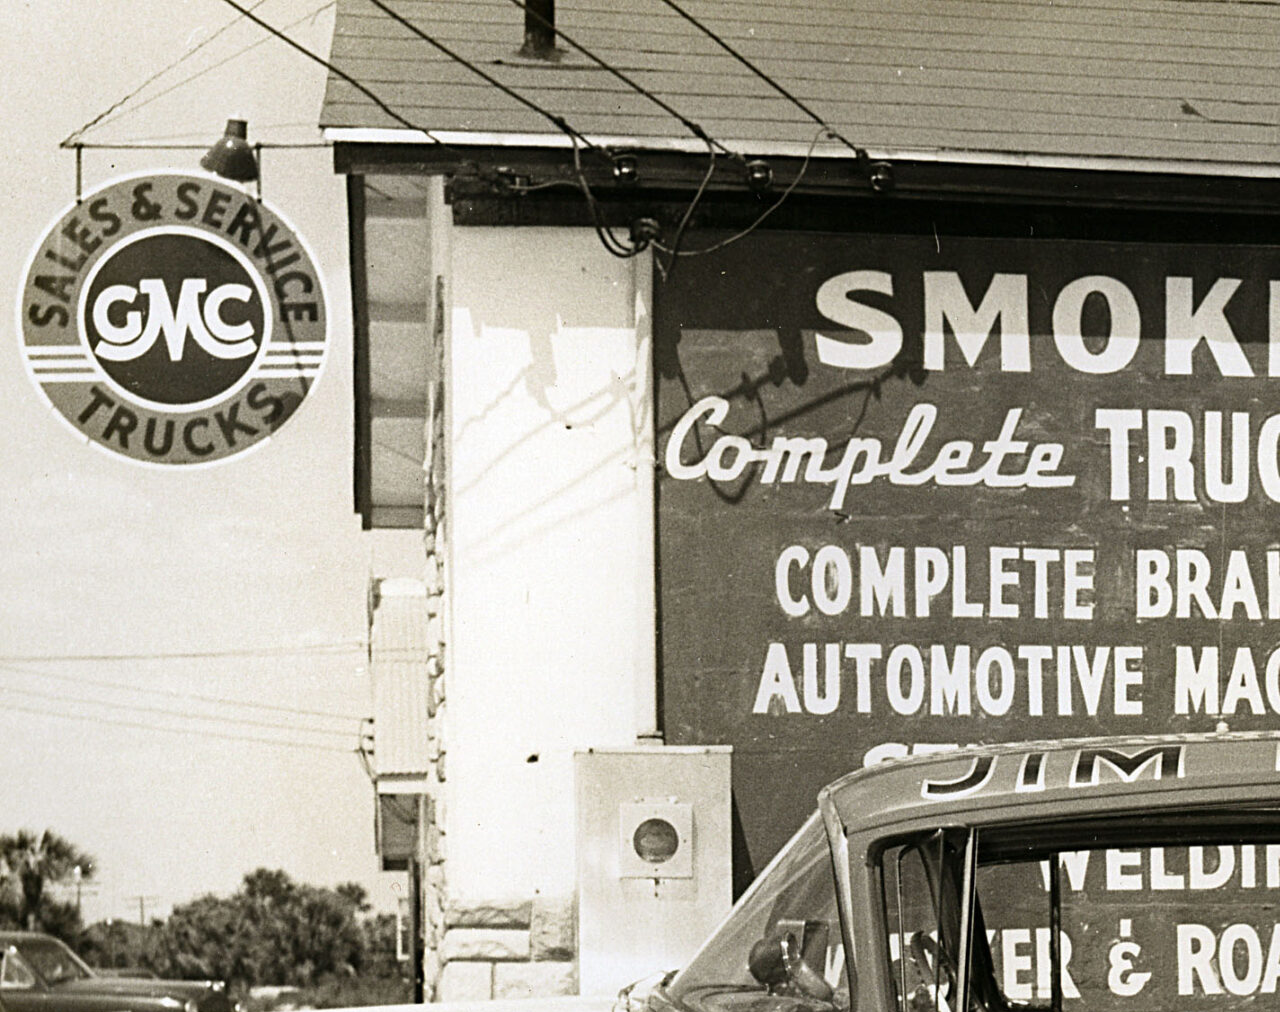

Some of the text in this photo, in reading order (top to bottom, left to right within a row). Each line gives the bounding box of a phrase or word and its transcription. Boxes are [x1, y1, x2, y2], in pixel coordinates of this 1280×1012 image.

[28, 182, 318, 328] SALES & SERVICE
[92, 278, 258, 361] GMC
[77, 383, 284, 456] TRUCKS
[665, 397, 1076, 510] Complete
[775, 545, 1095, 621] COMPLETE
[752, 642, 1144, 716] AUTOMOTIVE
[921, 745, 1187, 800] JIM
[1108, 919, 1152, 996] &
